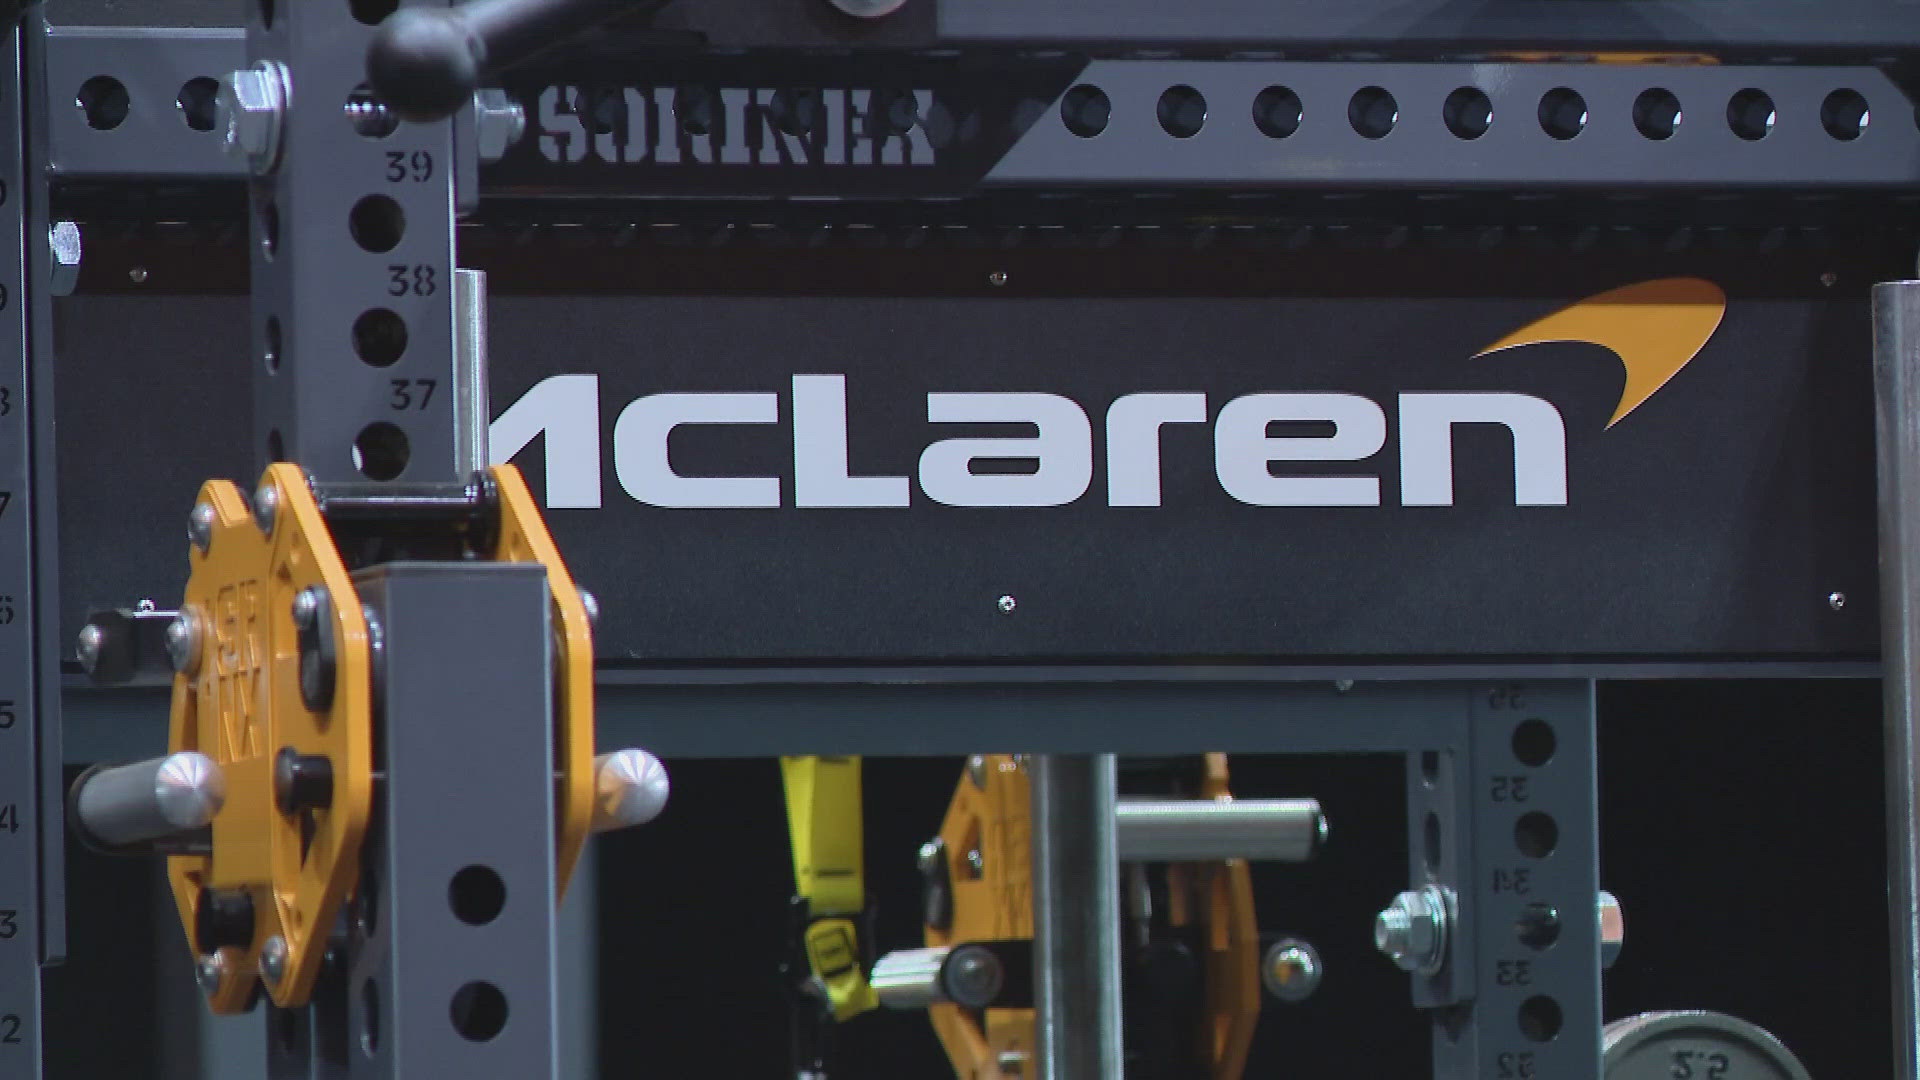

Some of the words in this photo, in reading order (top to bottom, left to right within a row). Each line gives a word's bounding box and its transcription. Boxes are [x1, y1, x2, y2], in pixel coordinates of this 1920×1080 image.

[386, 151, 432, 182] 39
[388, 264, 436, 296] 38
[391, 378, 437, 411] 37
